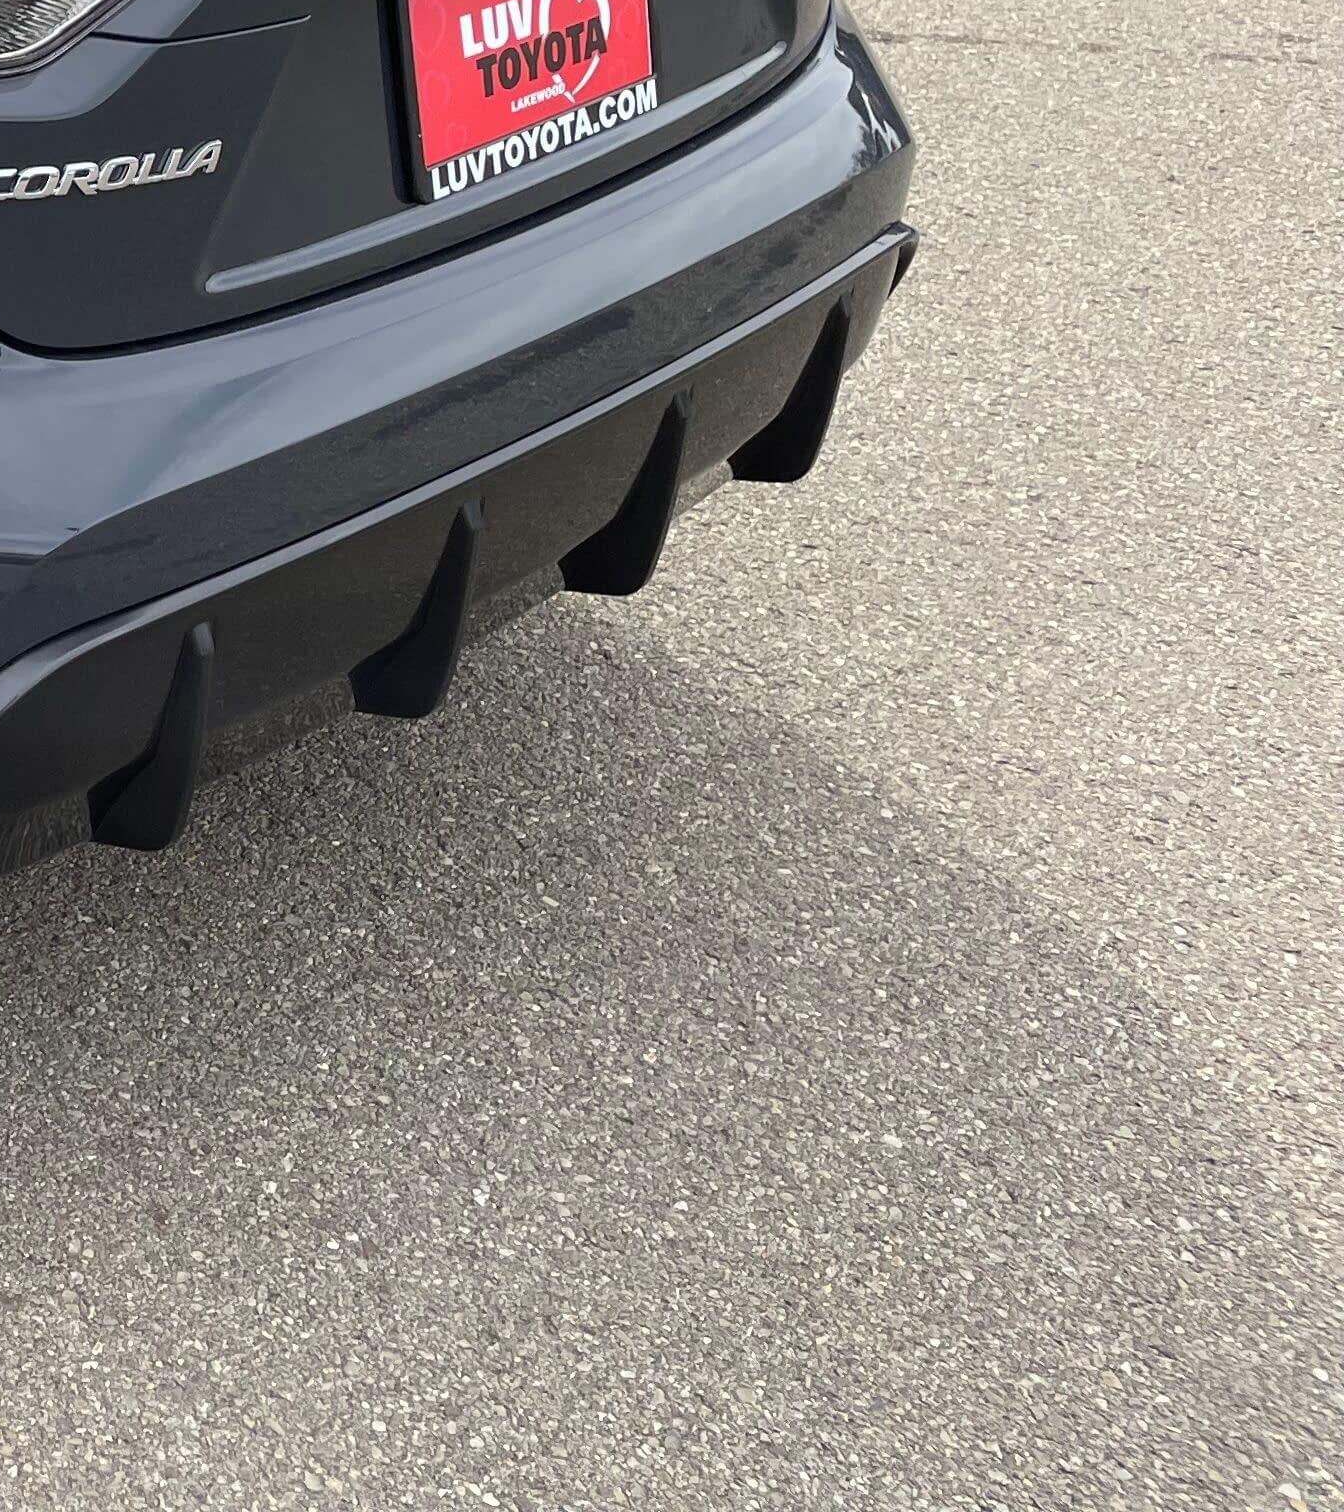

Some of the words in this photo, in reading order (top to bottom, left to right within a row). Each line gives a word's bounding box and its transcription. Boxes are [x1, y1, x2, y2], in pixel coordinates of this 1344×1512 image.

[476, 16, 608, 98] TOYOTA
[511, 81, 567, 113] LAKEWOOD
[431, 79, 658, 200] LUVTOYOTA.COM
